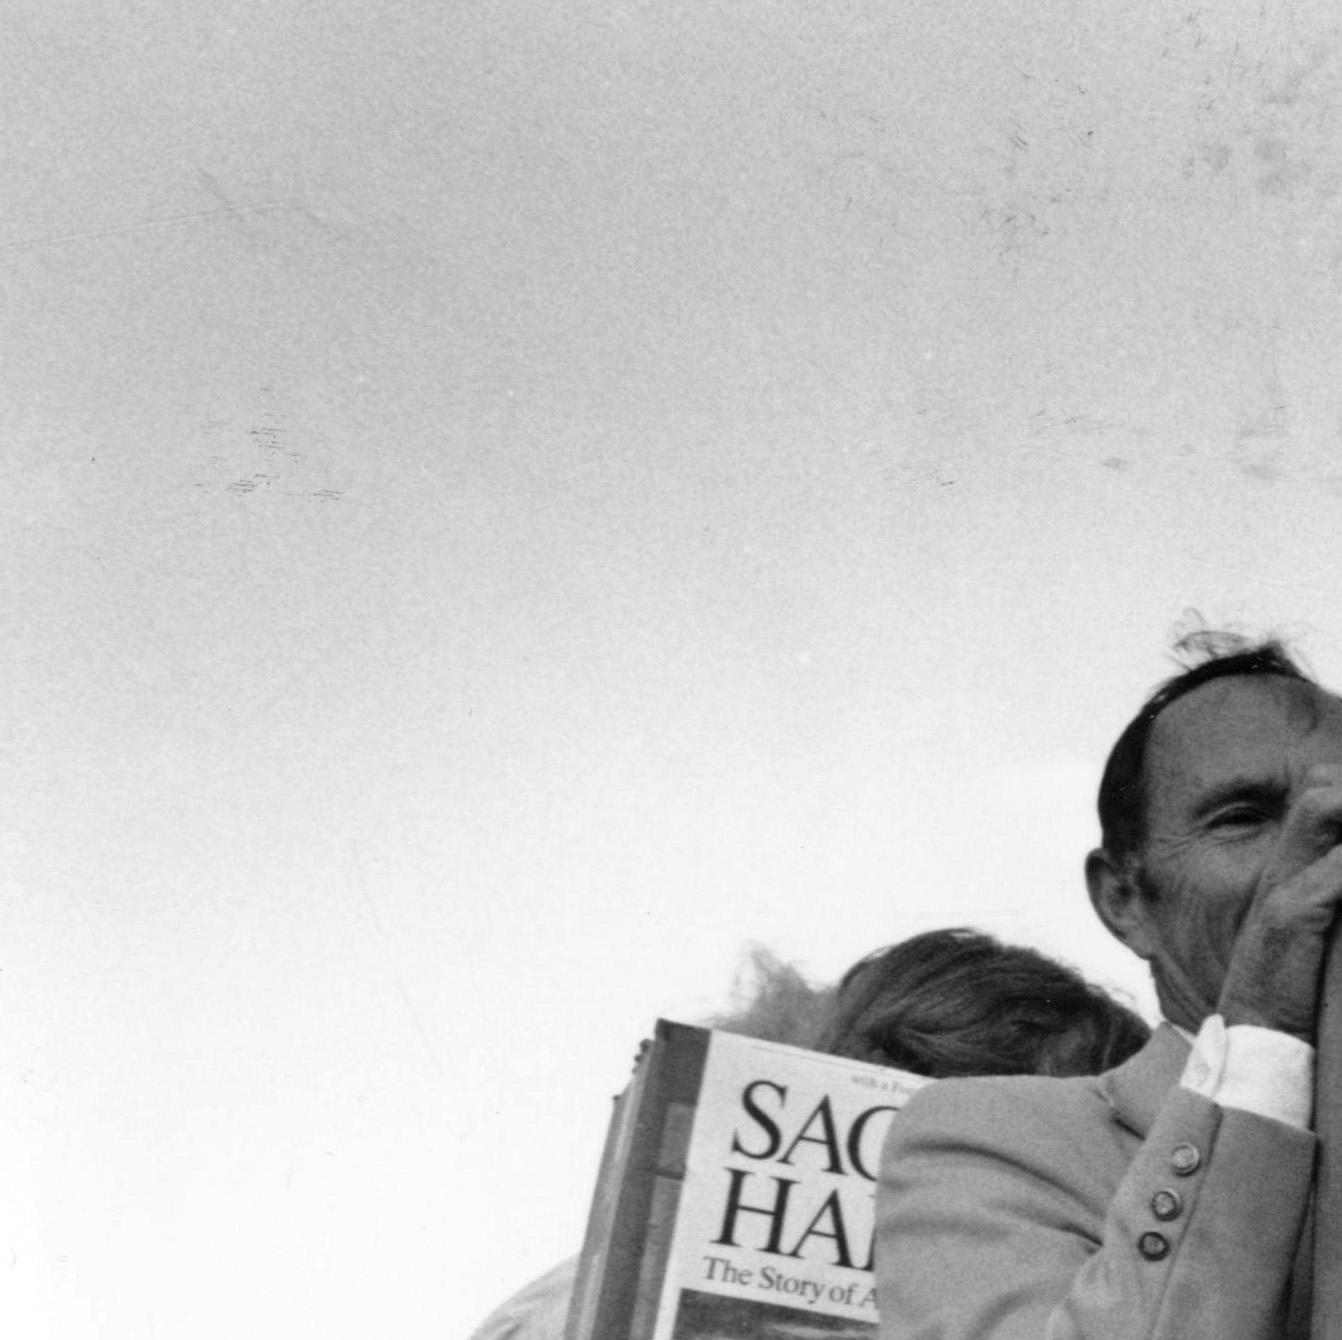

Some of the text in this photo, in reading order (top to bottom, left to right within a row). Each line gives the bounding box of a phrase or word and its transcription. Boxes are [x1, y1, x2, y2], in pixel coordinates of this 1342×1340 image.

[709, 1166, 877, 1273] HA
[702, 1255, 755, 1287] The
[757, 1265, 827, 1305] Story
[828, 1281, 860, 1307] of
